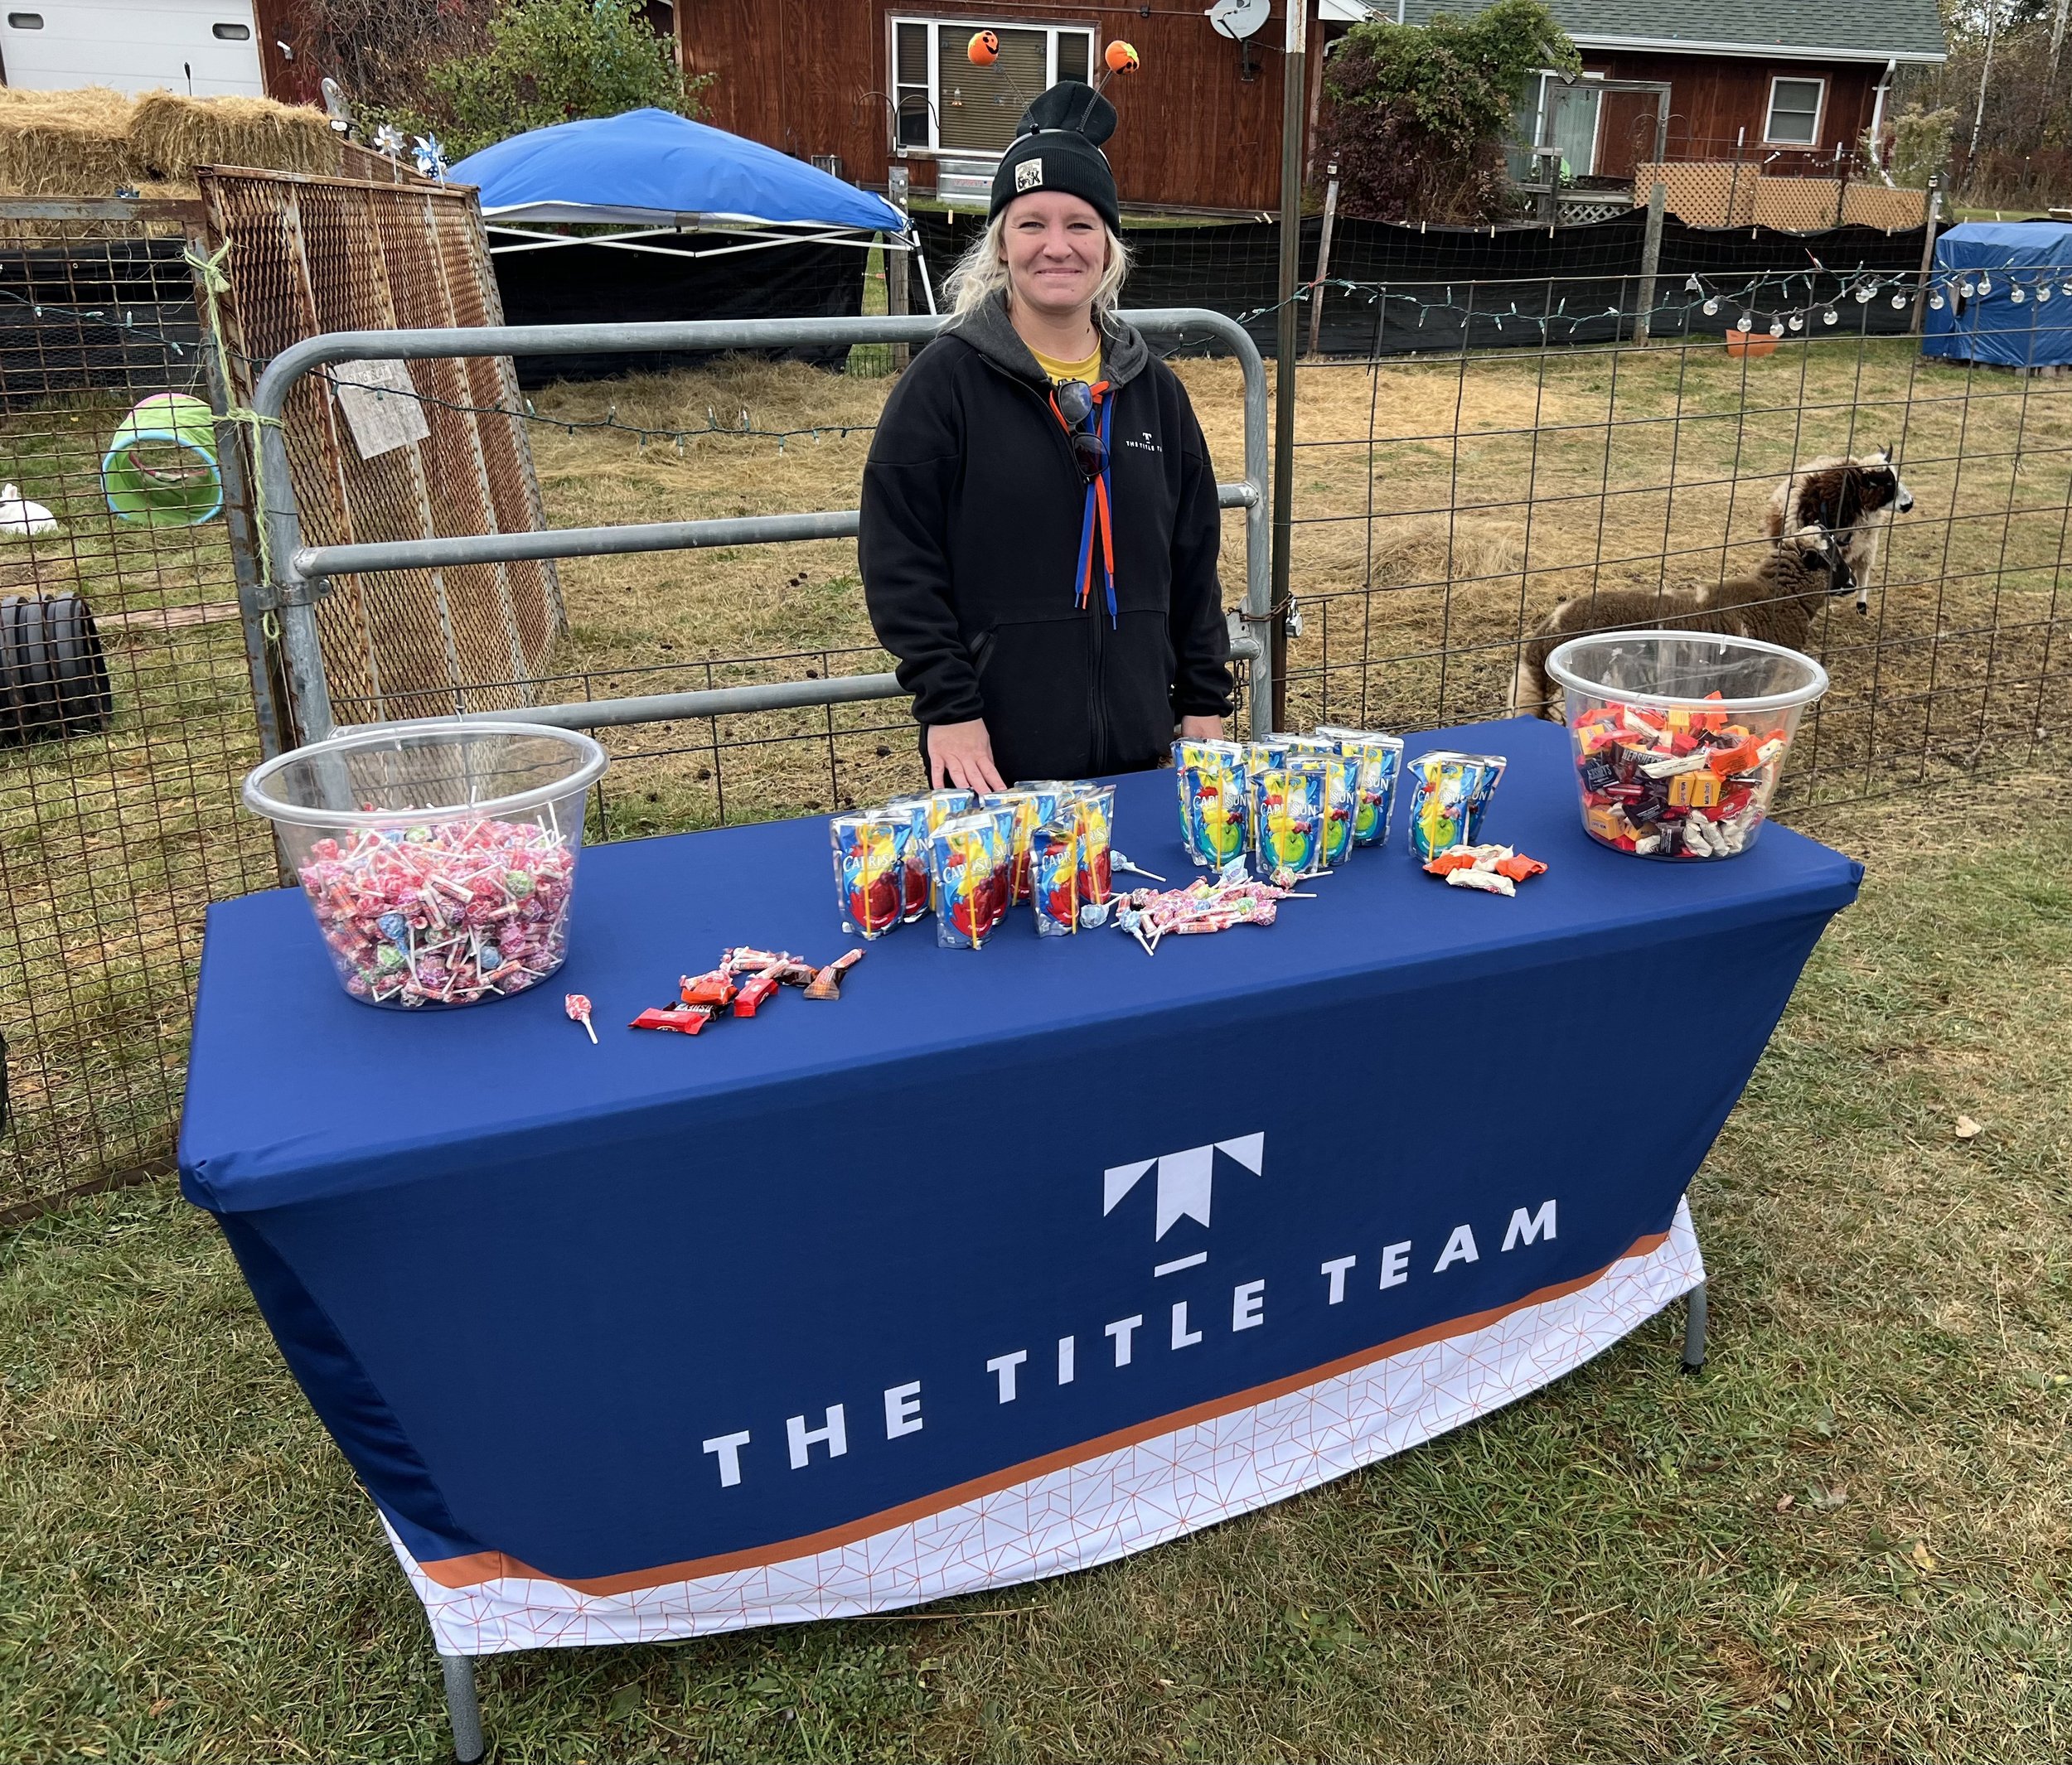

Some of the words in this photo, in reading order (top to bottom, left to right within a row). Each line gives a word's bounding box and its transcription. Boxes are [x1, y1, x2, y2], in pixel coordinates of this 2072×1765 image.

[1139, 442, 1155, 452] TITLE
[1366, 771, 1389, 791] SUN
[1329, 789, 1354, 805] SUN
[1472, 791, 1489, 801] UN
[1042, 851, 1072, 873] CAPR
[702, 1380, 923, 1487] THE
[986, 1279, 1265, 1405] TITLE
[1320, 1199, 1556, 1305] TEAM
